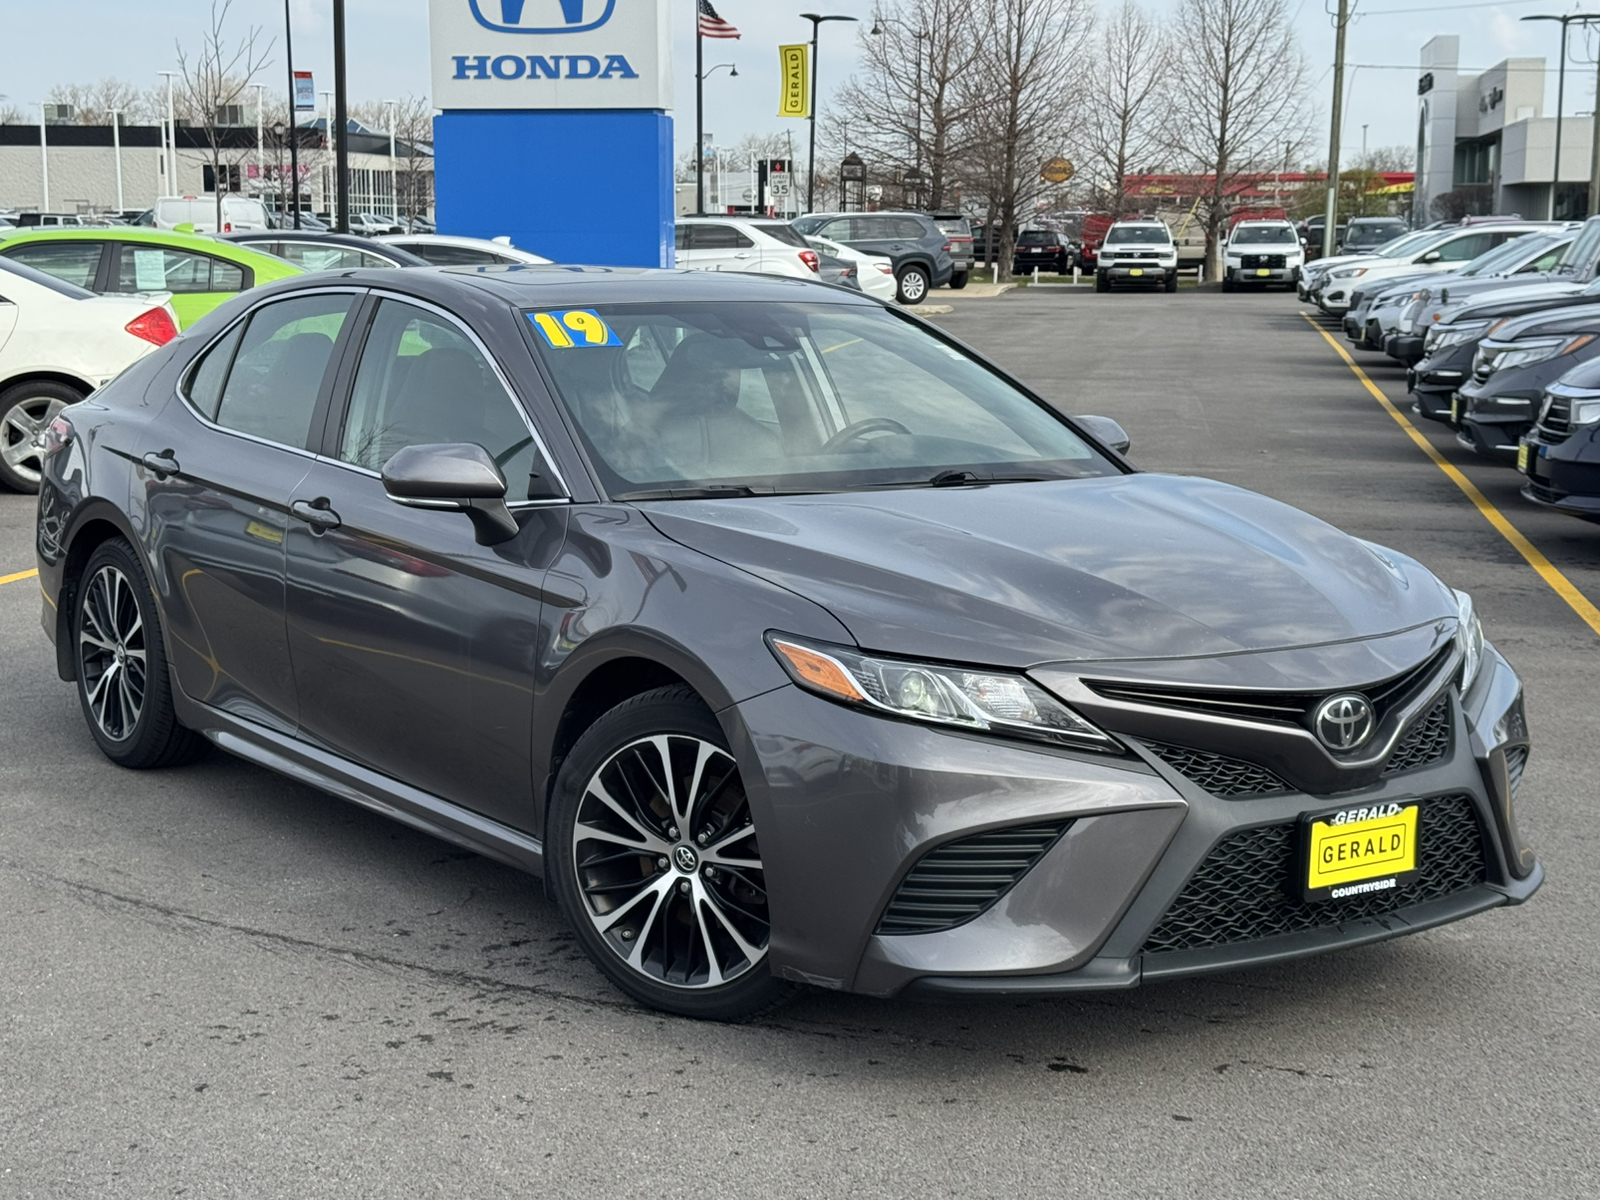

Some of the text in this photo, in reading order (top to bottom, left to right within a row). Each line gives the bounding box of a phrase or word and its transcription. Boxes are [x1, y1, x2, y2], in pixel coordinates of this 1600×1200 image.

[451, 54, 639, 80] HONDA
[790, 53, 799, 108] GERALD
[773, 185, 788, 194] 35
[534, 311, 608, 348] 19
[1335, 803, 1398, 825] GERALD
[1323, 833, 1401, 864] GERALD
[1331, 878, 1396, 898] COUNTRYSIDE
